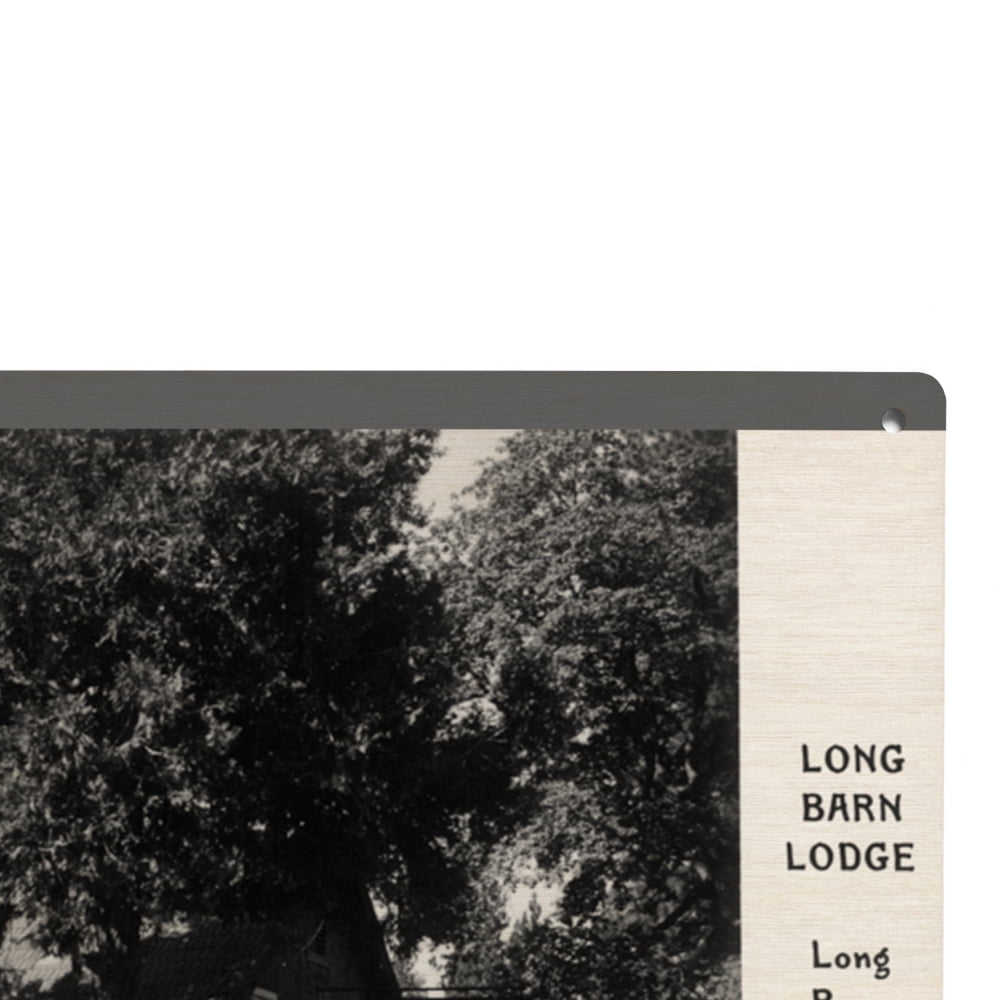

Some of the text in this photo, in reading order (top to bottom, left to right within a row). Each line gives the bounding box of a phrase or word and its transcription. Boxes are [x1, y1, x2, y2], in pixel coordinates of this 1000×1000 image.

[801, 743, 905, 774] LONG
[801, 792, 903, 822] BARN
[785, 841, 916, 872] LODGE
[811, 939, 891, 980] Long
